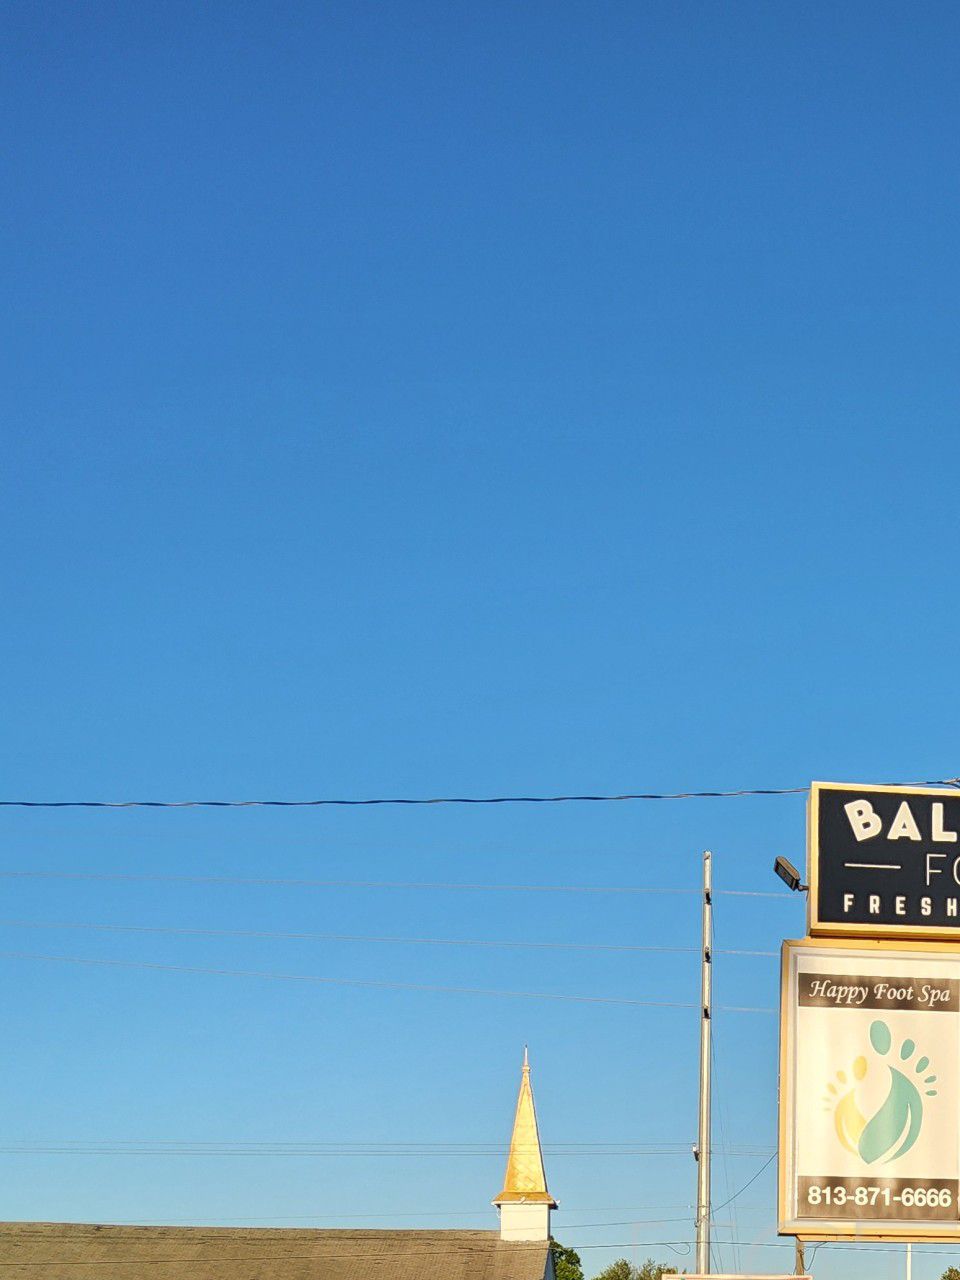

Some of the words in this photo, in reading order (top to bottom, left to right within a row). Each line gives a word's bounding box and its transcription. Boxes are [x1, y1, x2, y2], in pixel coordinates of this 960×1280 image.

[808, 979, 869, 1004] Happy
[874, 981, 914, 1000] Foot
[917, 984, 951, 1007] Spa
[807, 1186, 952, 1208] 813-871-6666
